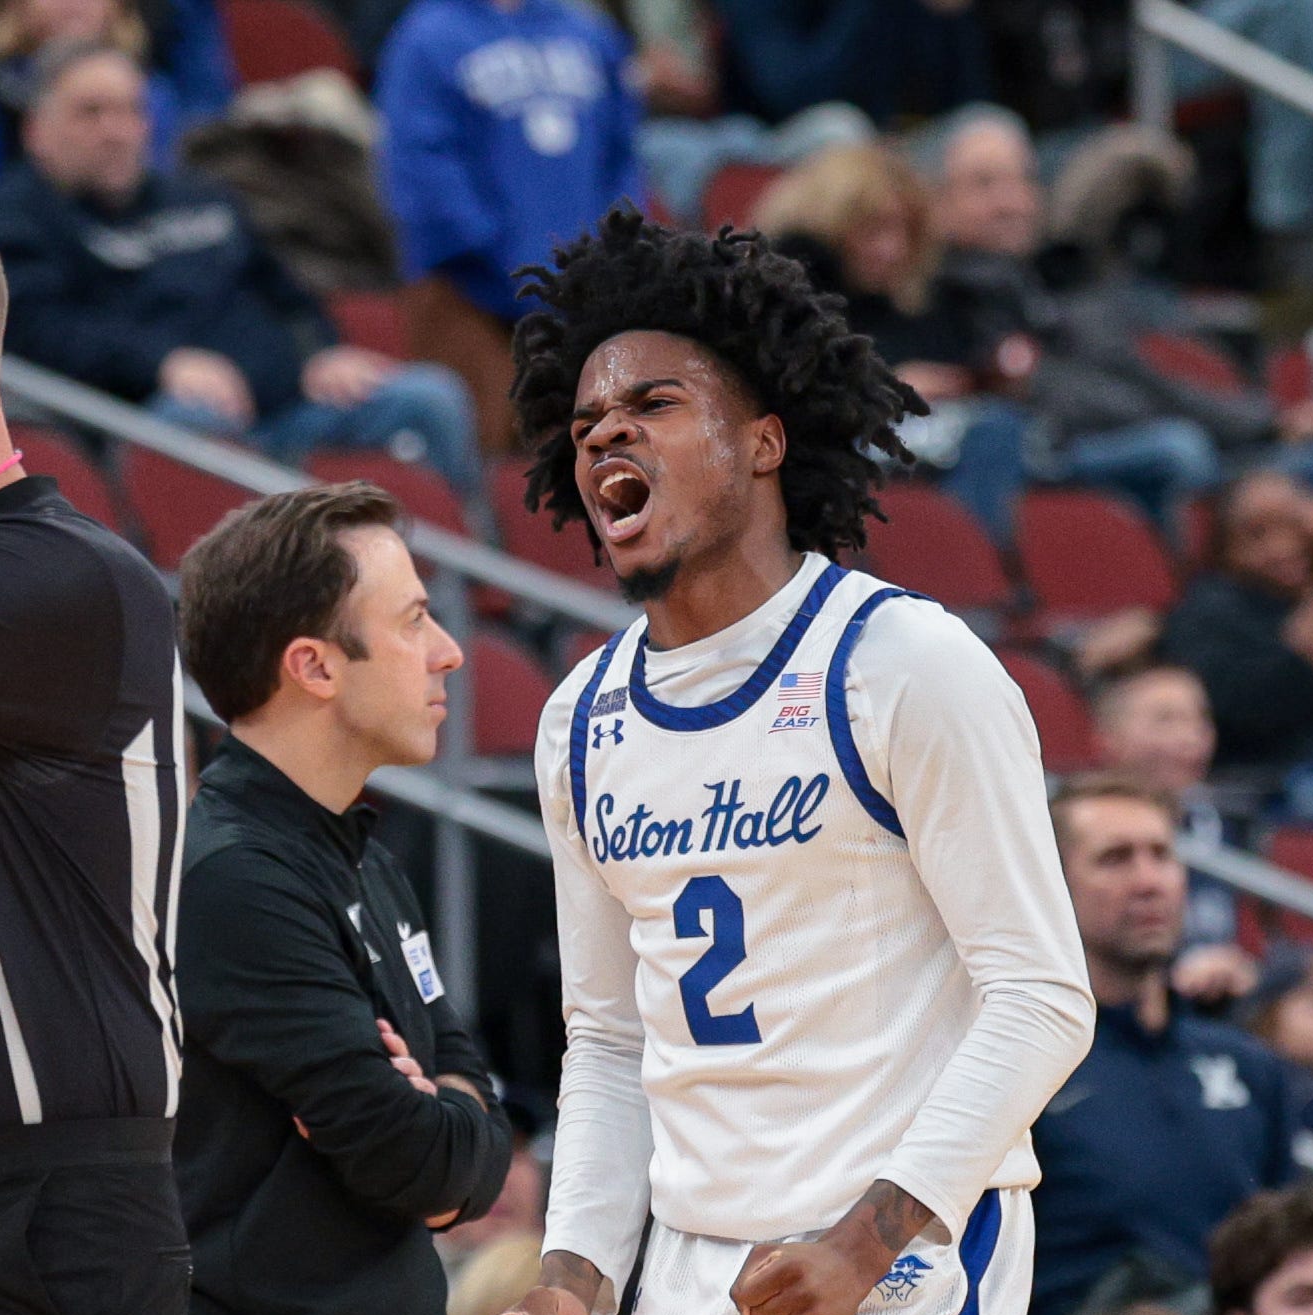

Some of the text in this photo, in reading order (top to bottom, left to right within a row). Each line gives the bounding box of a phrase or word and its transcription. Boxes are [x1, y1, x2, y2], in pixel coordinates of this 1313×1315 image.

[771, 717, 820, 728] EAST
[778, 705, 811, 717] BIG
[593, 772, 831, 864] Seton Hall
[673, 875, 763, 1046] 2
